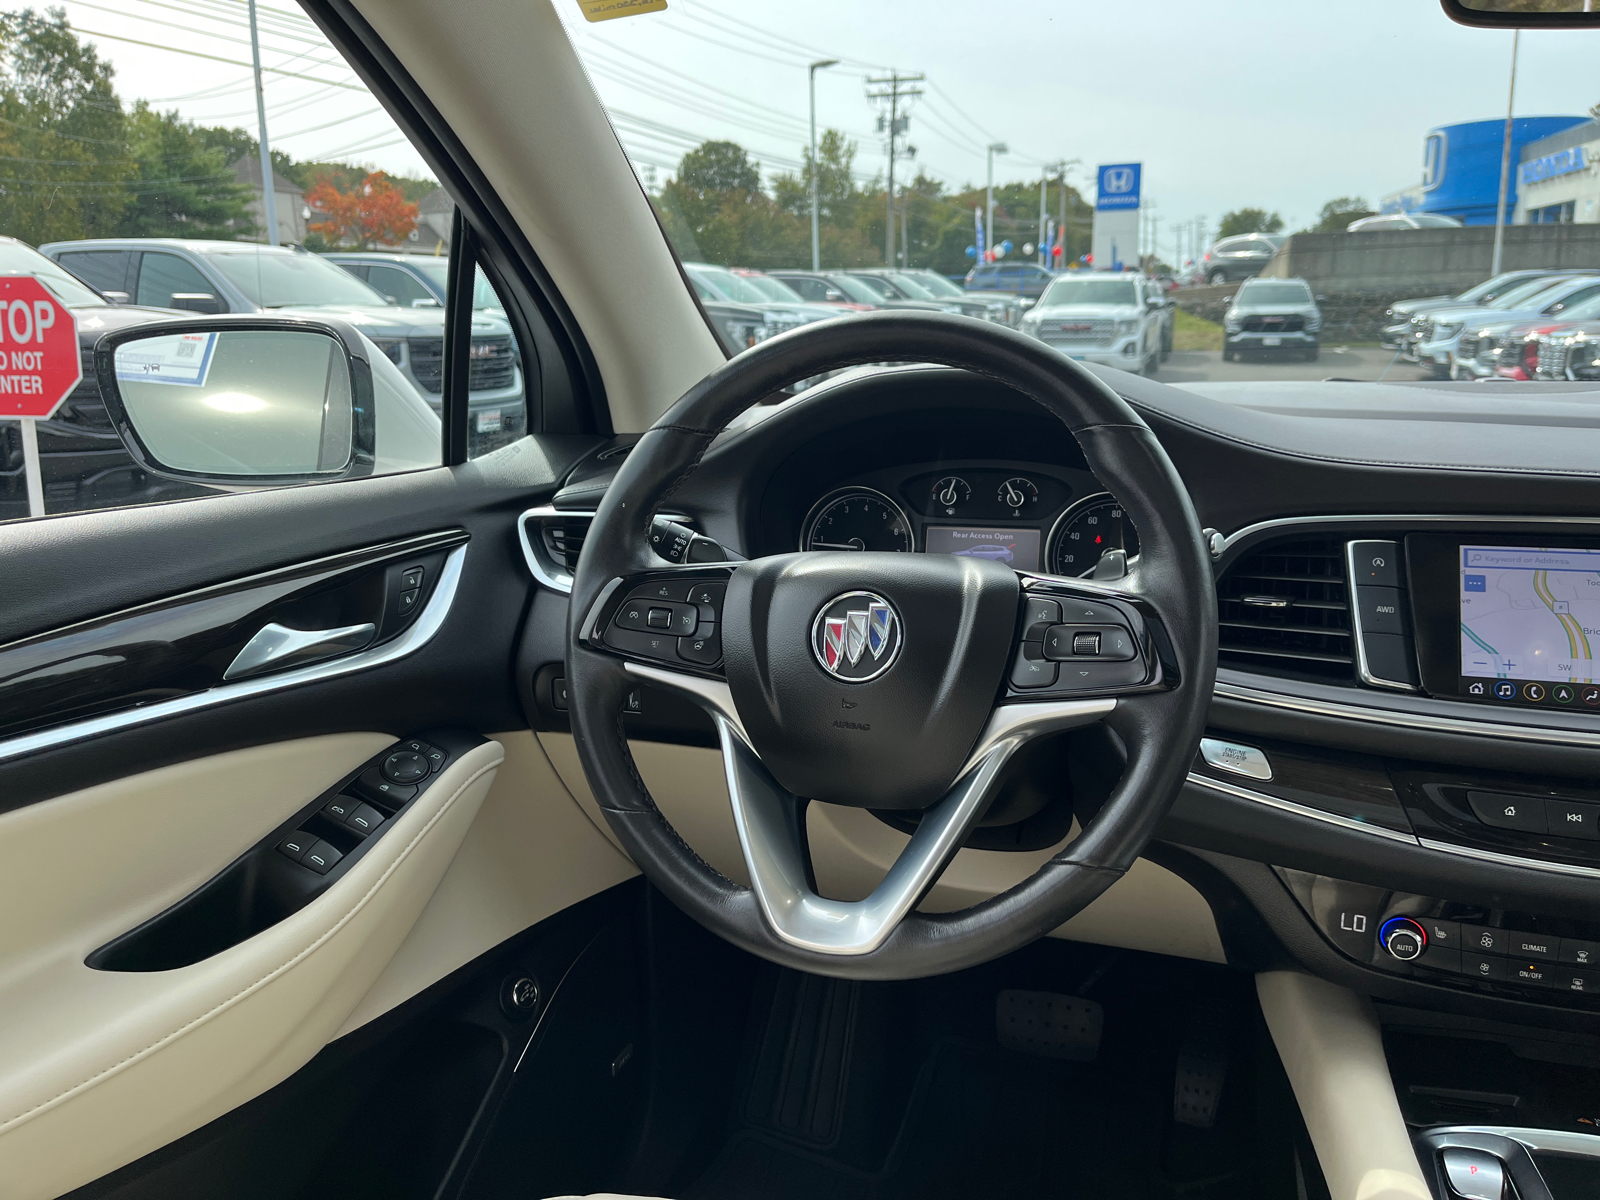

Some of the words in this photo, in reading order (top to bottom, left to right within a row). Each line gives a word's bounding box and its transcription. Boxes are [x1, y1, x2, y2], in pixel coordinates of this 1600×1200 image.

[1521, 147, 1585, 185] HONDA
[0, 299, 55, 344] TOP
[0, 350, 8, 370] O
[11, 350, 44, 371] NOT
[0, 374, 44, 394] NTER
[844, 505, 849, 514] 3
[1111, 510, 1121, 518] 80
[882, 512, 887, 520] 5
[1087, 516, 1098, 525] 60
[828, 517, 833, 525] 2
[893, 528, 899, 536] 6
[952, 531, 968, 539] Rear
[969, 532, 993, 540] Access
[994, 533, 1014, 542] Open
[1069, 532, 1080, 541] 40
[674, 536, 687, 546] AUTO
[1064, 554, 1074, 563] 20
[1484, 555, 1522, 564] Keyword
[1534, 557, 1570, 565] Address
[1376, 605, 1395, 614] AWD
[832, 720, 871, 731] AIRBAG
[1224, 746, 1247, 756] ENGINE
[1340, 912, 1367, 933] LO
[1396, 944, 1413, 952] AUTO
[1521, 943, 1547, 953] CLIMATE
[1519, 970, 1543, 979] ON/OFF
[1470, 1165, 1478, 1174] P
